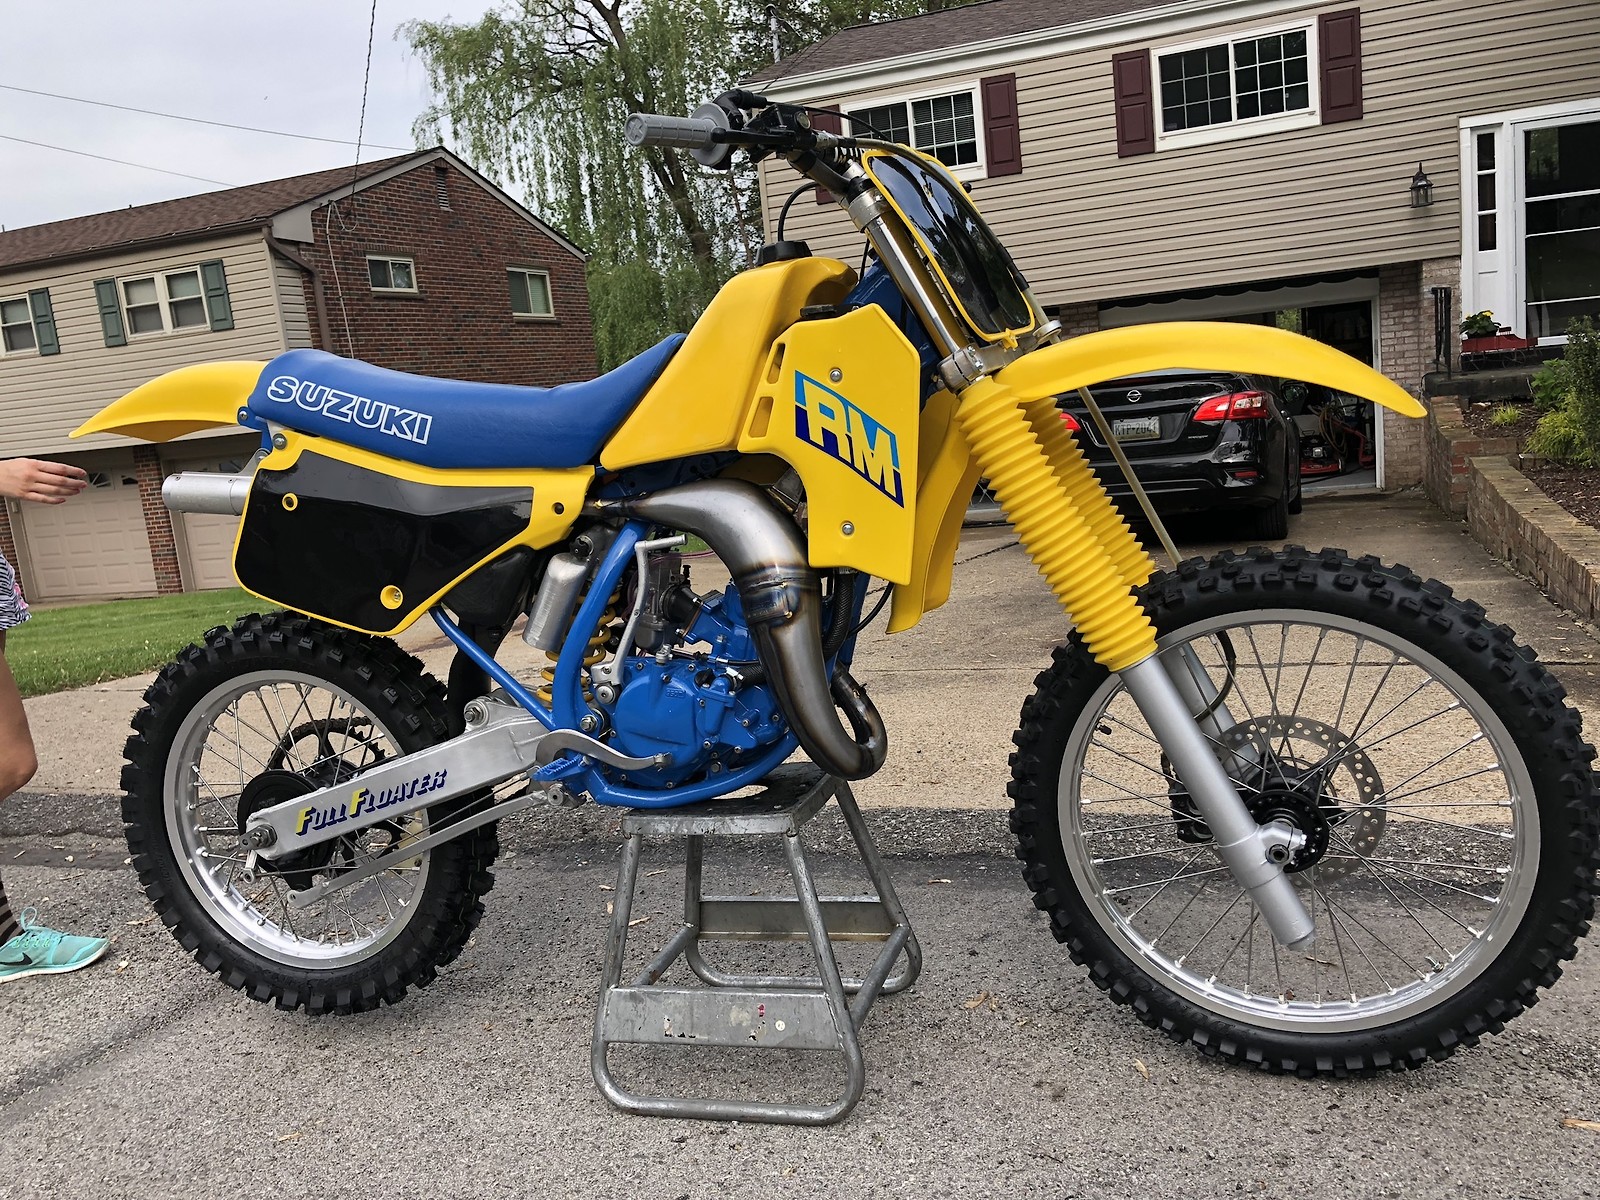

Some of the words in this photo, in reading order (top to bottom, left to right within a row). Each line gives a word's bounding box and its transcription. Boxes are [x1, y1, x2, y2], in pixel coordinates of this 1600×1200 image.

[267, 376, 432, 445] SUZUKI
[802, 378, 898, 499] RM
[295, 804, 348, 836] FULL
